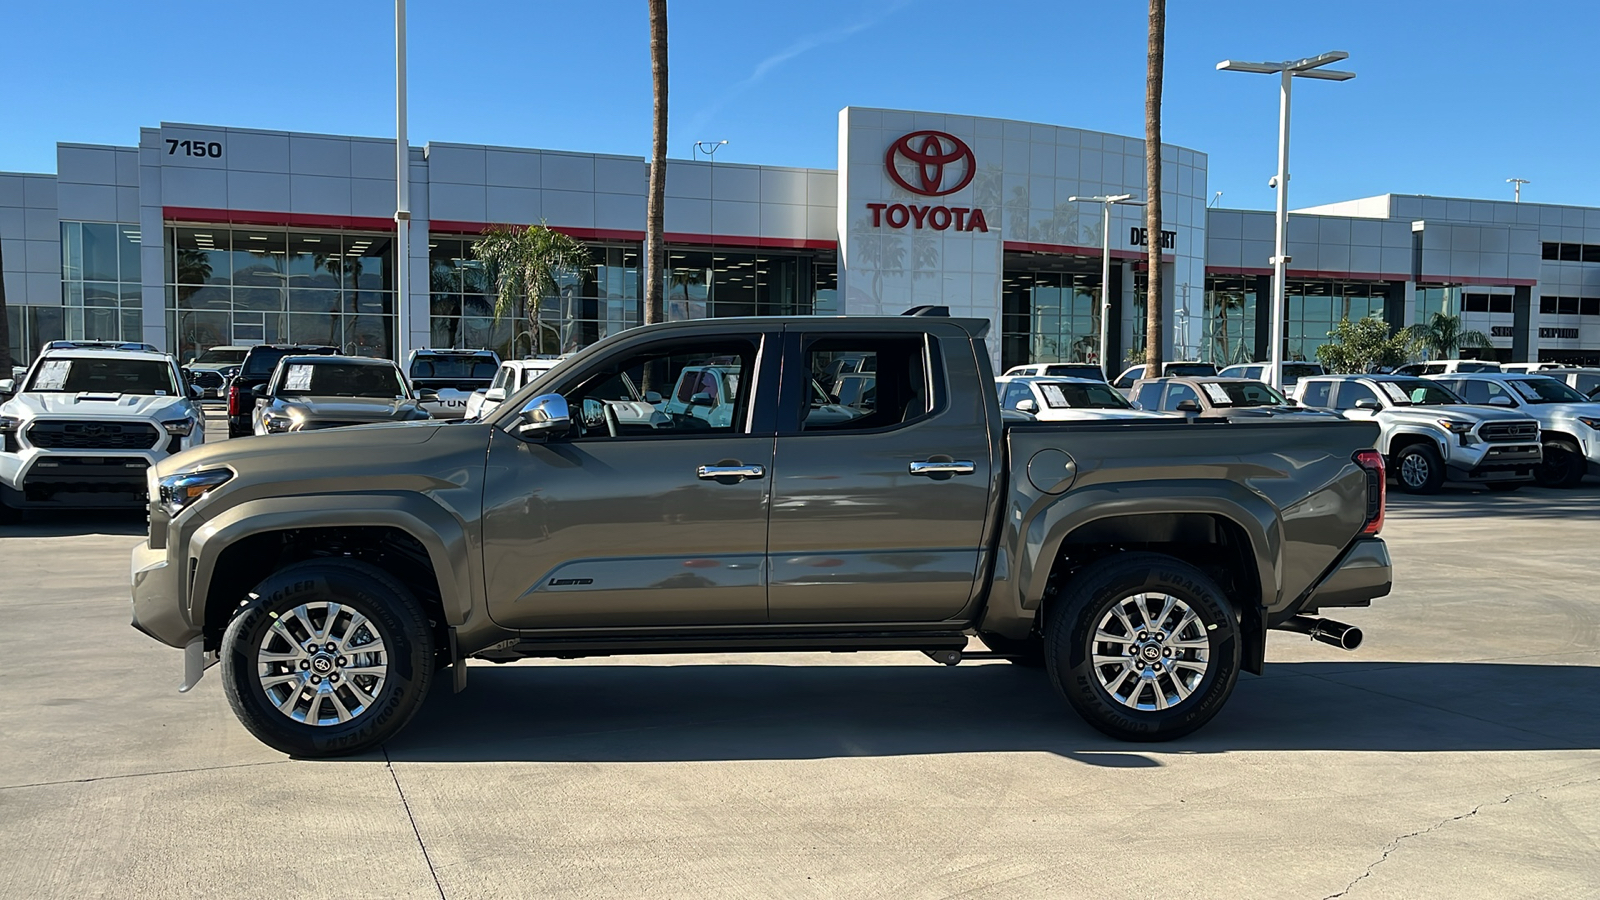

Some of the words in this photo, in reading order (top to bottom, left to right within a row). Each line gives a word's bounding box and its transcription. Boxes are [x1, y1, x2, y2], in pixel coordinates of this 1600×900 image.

[166, 138, 222, 158] 7150
[866, 203, 989, 233] TOYOTA
[1130, 227, 1177, 249] DERT
[237, 580, 315, 641] WRANGLER
[1158, 571, 1228, 628] WRANGLER
[326, 686, 404, 748] GOODYEAR
[1076, 675, 1149, 732] GOODYEAR
